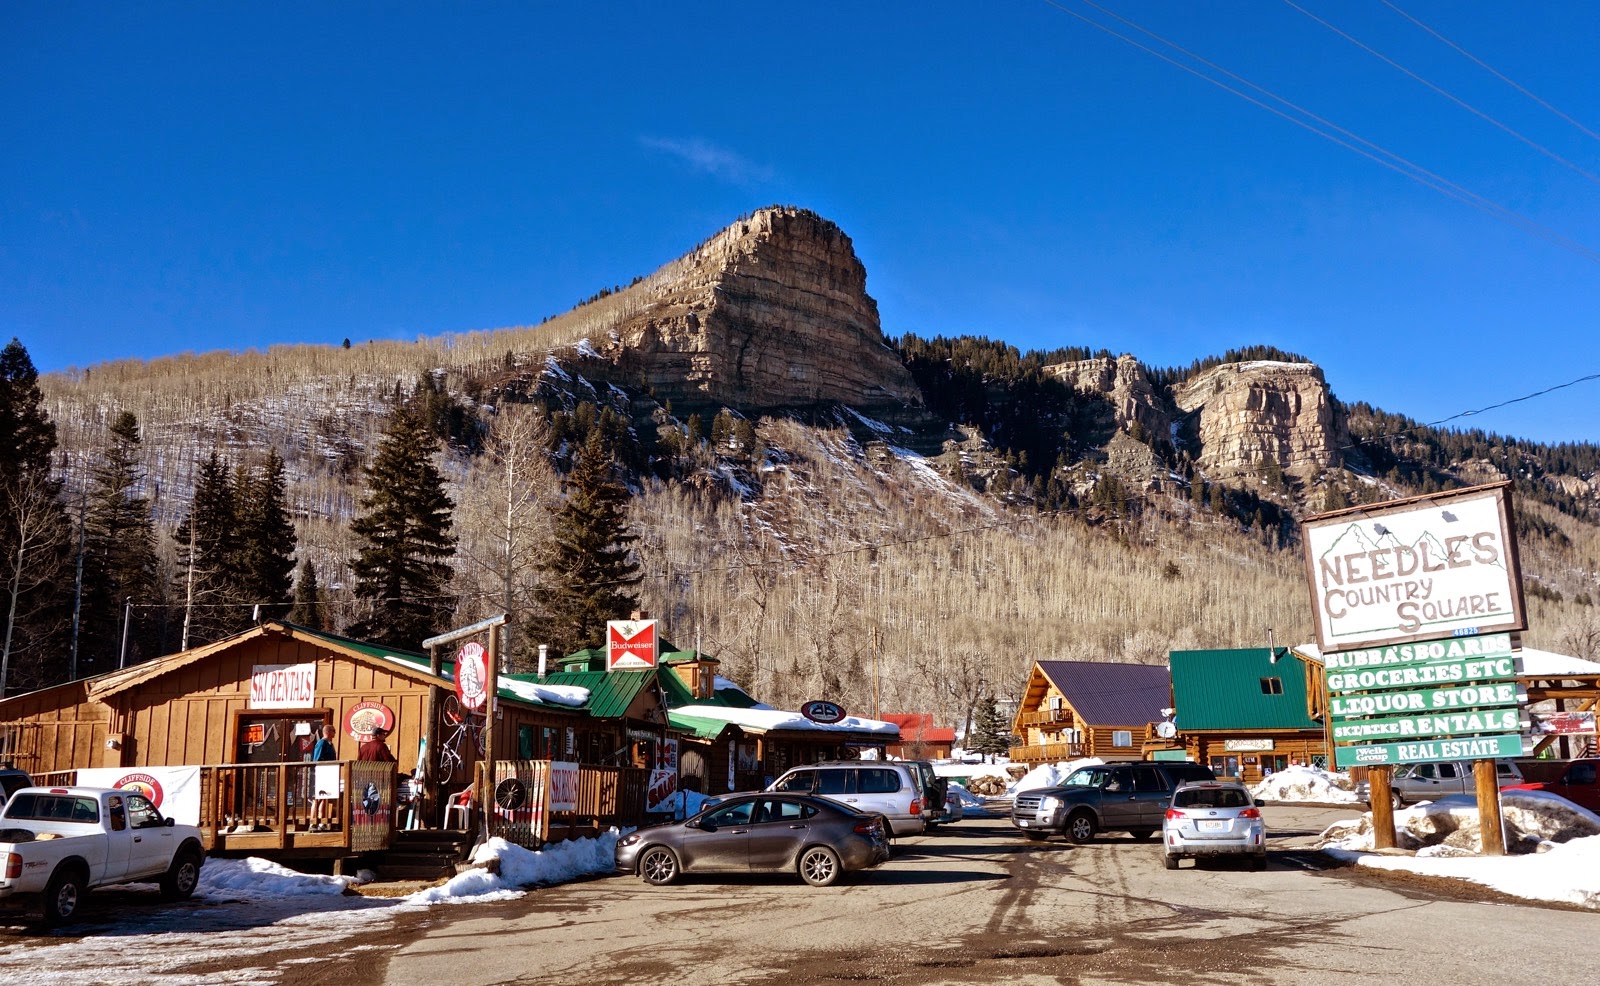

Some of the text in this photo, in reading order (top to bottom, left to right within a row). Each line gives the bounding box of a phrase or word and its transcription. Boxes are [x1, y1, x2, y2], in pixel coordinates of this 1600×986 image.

[1319, 531, 1498, 587] NEEDLES
[1325, 578, 1432, 618] COUNTRY
[1397, 592, 1501, 633] SQUARE
[611, 641, 653, 650] Budweiser
[1454, 627, 1478, 636] 46825
[1325, 635, 1509, 668] BUBBA'S BOARDS
[252, 670, 311, 702] SKI RENTALS
[1328, 659, 1511, 690] GROCERIES ETC
[353, 702, 384, 711] CLIFFSIDE
[1332, 685, 1513, 714] LIQUOR STORE
[1399, 712, 1517, 736] RENTALS
[1397, 739, 1499, 760] REAL ESTATE
[120, 774, 156, 785] CLIFFSIDE
